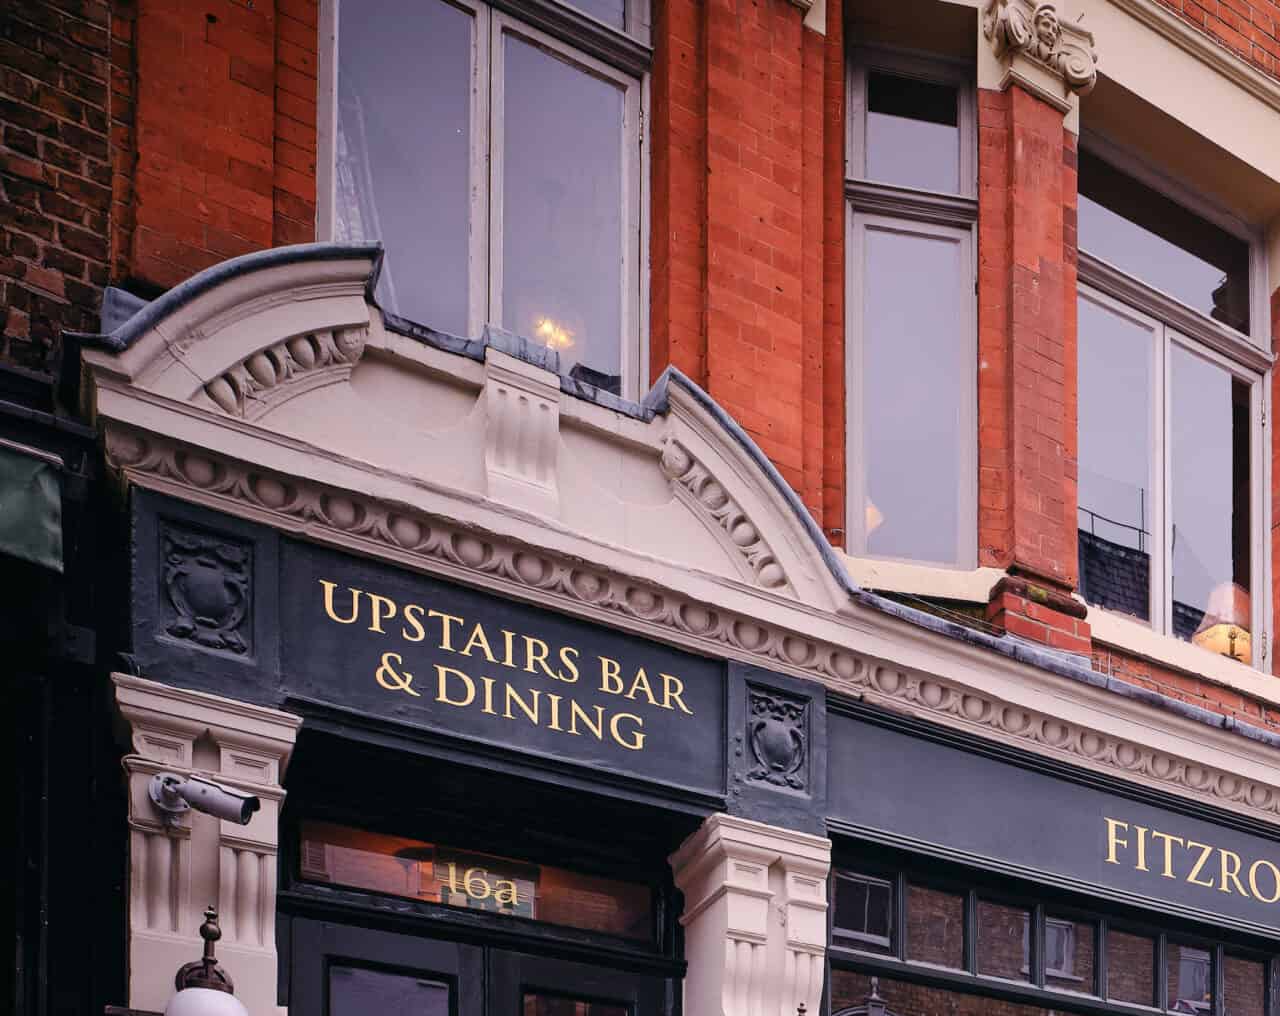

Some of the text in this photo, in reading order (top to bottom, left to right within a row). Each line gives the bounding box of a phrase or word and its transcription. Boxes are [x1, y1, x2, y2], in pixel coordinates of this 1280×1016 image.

[319, 578, 694, 715] UPSTAIRS BAR
[375, 651, 648, 751] & DINING
[447, 863, 519, 906] 16a
